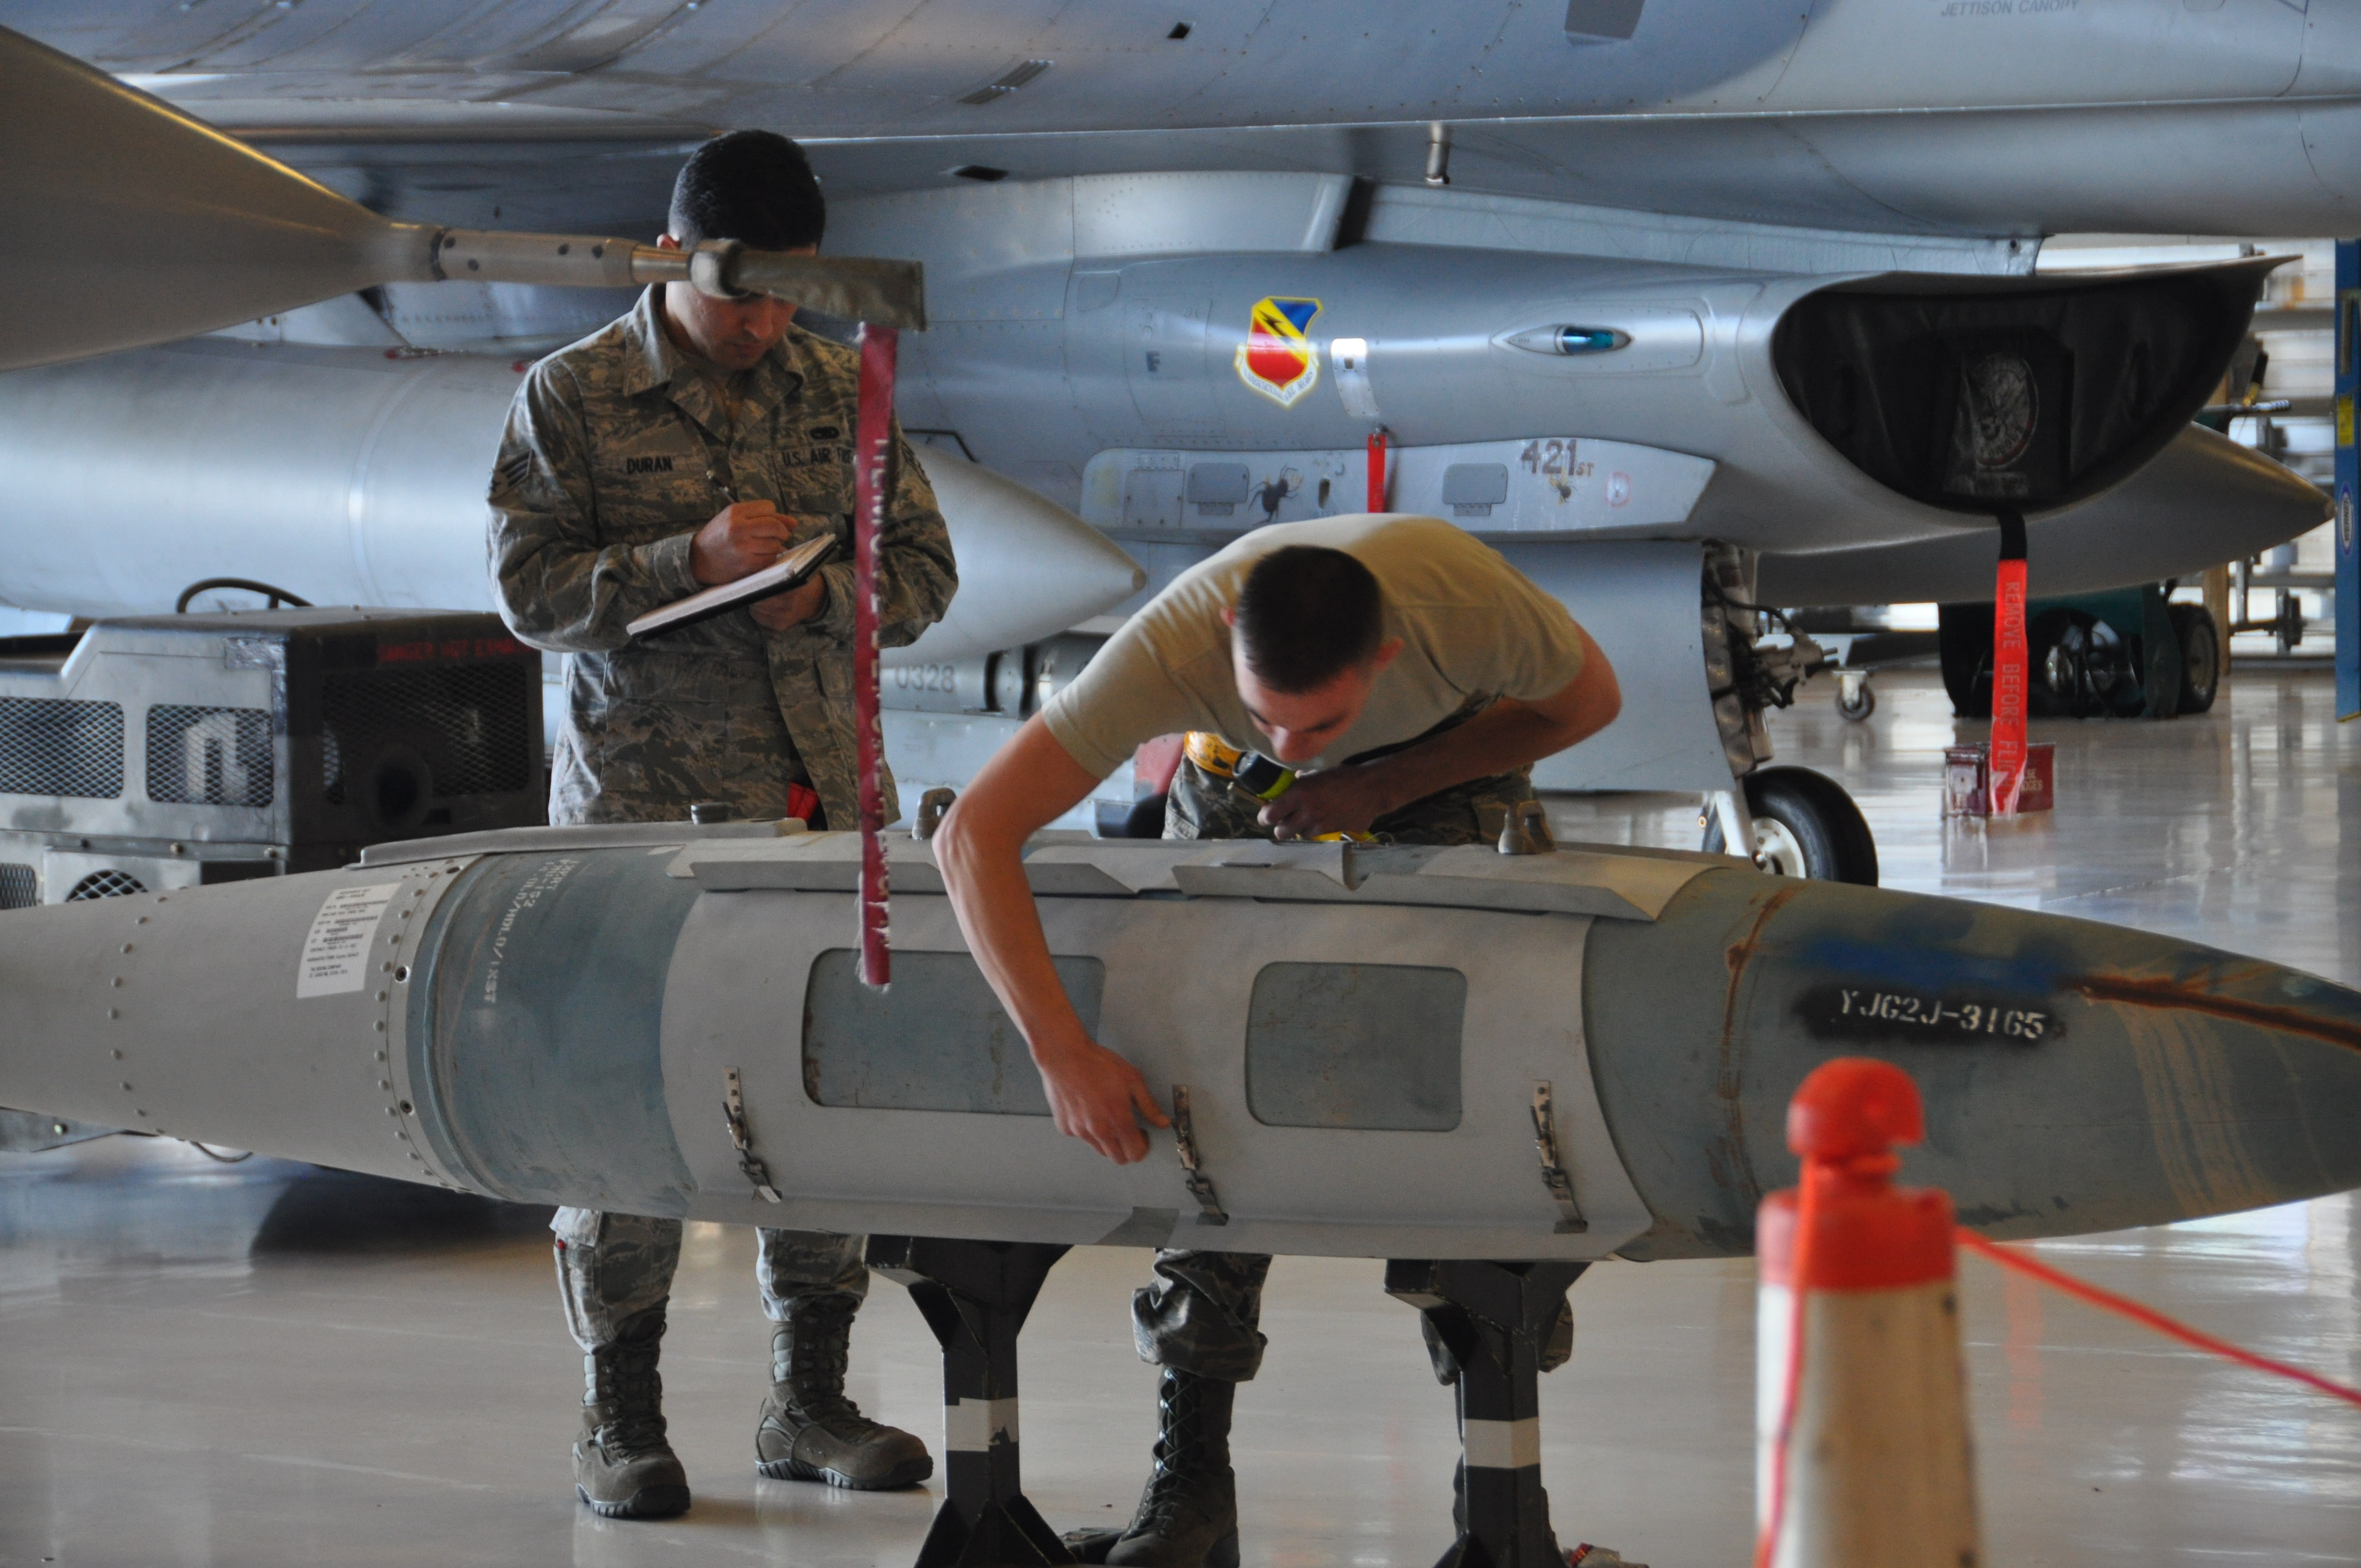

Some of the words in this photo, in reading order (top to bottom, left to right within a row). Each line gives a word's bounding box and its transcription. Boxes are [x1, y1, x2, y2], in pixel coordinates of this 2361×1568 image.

[1941, 0, 2013, 17] JETTISON
[2019, 0, 2080, 13] CANOPY
[626, 456, 673, 475] DURAN
[810, 447, 832, 465] AIR
[2003, 580, 2021, 649] REMOVE
[2000, 662, 2021, 726] BEFORE
